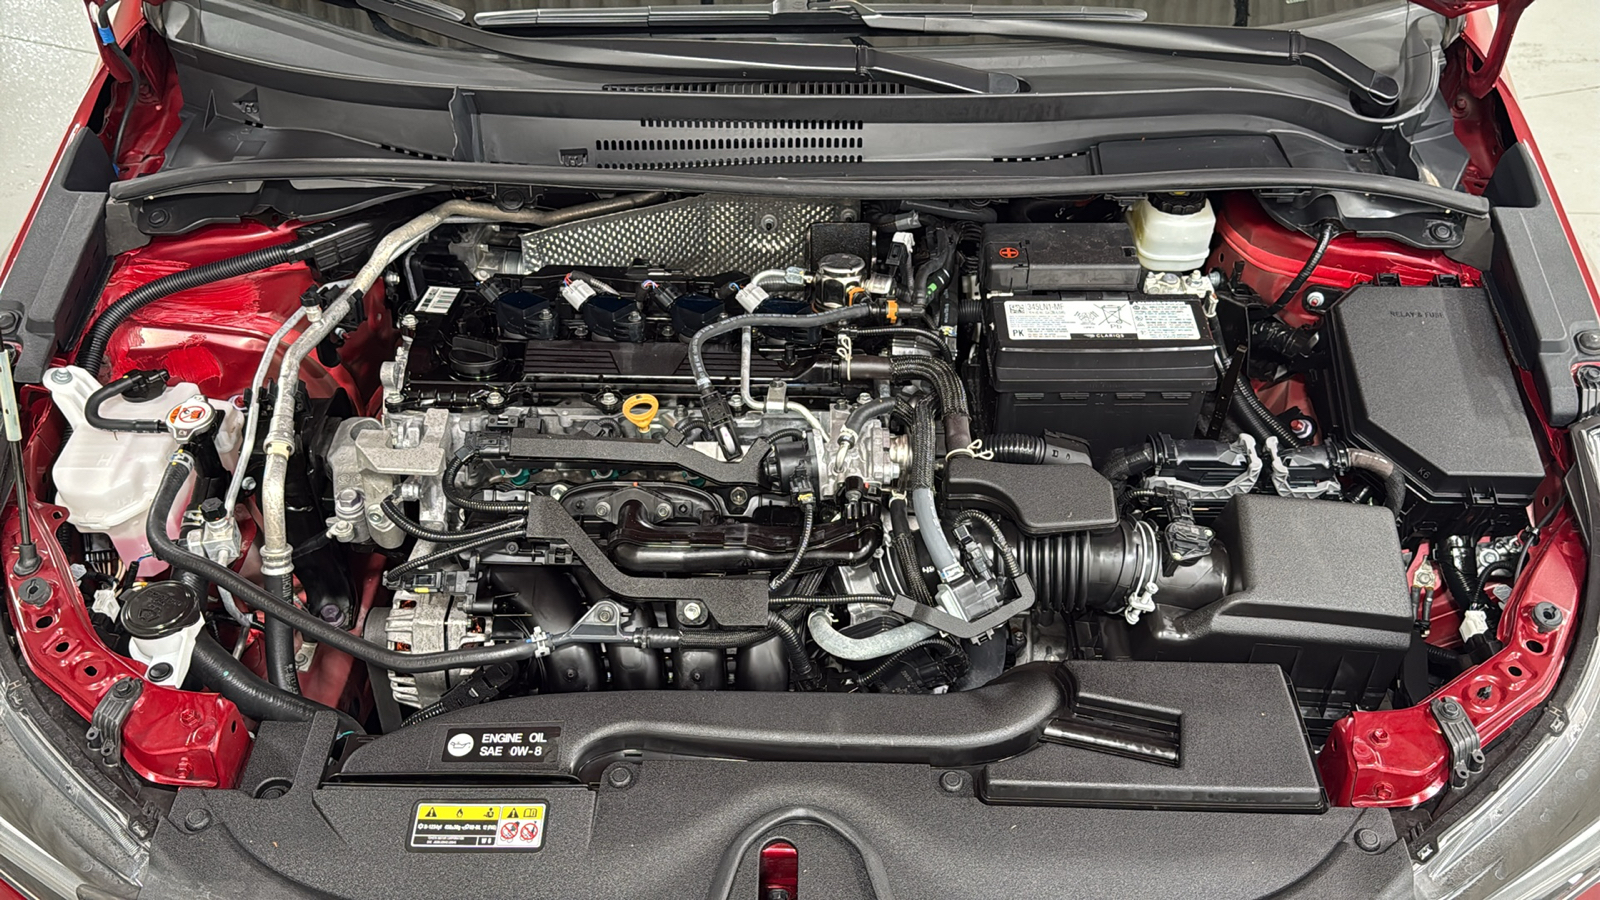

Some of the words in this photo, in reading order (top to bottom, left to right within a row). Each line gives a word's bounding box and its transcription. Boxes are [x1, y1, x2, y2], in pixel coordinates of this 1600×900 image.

[1012, 329, 1025, 337] PK
[1417, 466, 1431, 480] K6
[481, 733, 523, 743] ENGINE
[528, 733, 547, 743] OIL
[479, 746, 503, 756] SAE
[509, 746, 543, 756] 0W-8
